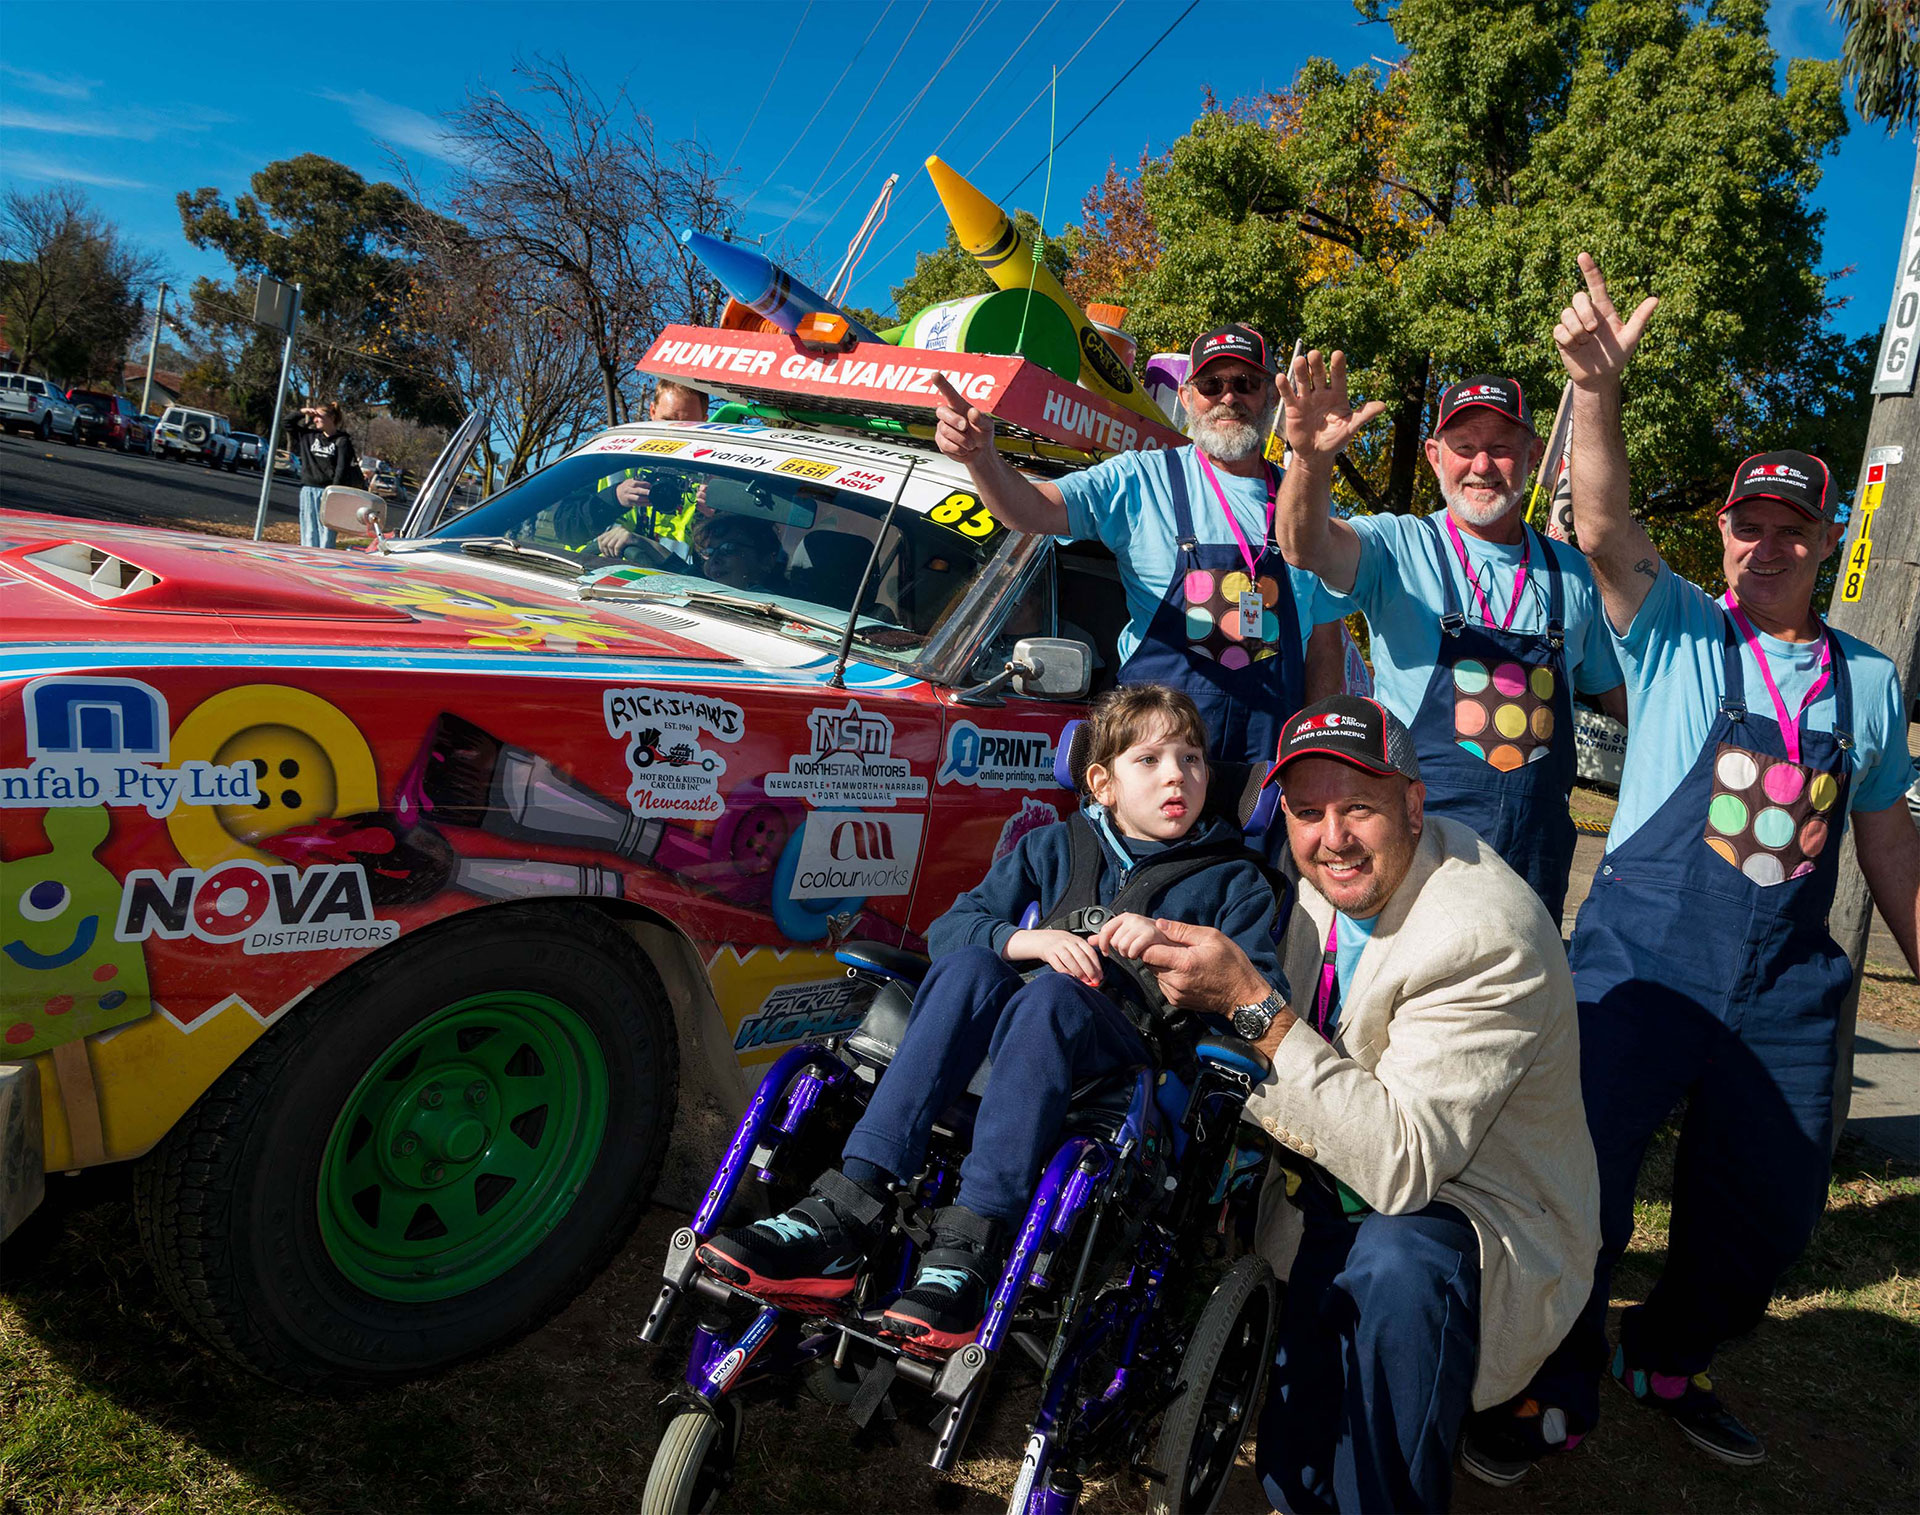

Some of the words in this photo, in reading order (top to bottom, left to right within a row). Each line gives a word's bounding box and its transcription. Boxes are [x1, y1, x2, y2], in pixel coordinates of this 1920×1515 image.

[1887, 212, 1920, 373] 406
[652, 340, 776, 375] HUNTER
[780, 354, 996, 400] GALVANIZING
[1043, 390, 1138, 451] HUNTER
[638, 443, 680, 453] BASH
[709, 449, 773, 469] variety
[781, 462, 828, 478] BASH
[847, 470, 886, 484] AHA
[834, 477, 877, 492] NSW
[931, 494, 995, 537] 85
[611, 695, 738, 735] RICKSHAWS
[664, 722, 677, 731] EST.
[678, 723, 693, 732] 1961
[812, 714, 888, 754] NSM
[1296, 721, 1312, 734] HG
[1574, 724, 1609, 741] ENNE
[1290, 732, 1315, 745] HUNTER
[1316, 730, 1366, 740] GALVANIZING
[1577, 737, 1626, 754] BATHURS
[640, 772, 655, 782] HOT
[657, 773, 673, 783] ROD
[681, 774, 711, 785] KUSTOM
[795, 762, 860, 777] NORTHSTAR
[862, 764, 907, 778] MOTORS
[980, 770, 1004, 781] online
[1006, 770, 1037, 784] printing,
[115, 767, 179, 810] Pty
[190, 767, 253, 799] Ltd
[650, 781, 665, 790] CAR
[666, 781, 684, 790] CLUB
[770, 780, 825, 790] NEWCASTLE
[831, 781, 879, 790] TAMWORTH
[885, 782, 925, 791] NARRABRI
[634, 788, 719, 812] Newcastle
[818, 791, 840, 800] PORT
[843, 792, 892, 801] MACQUARIE
[800, 865, 909, 889] colourworks
[124, 866, 367, 937] NOVA
[251, 926, 393, 949] DISTRIBUTORS
[773, 984, 820, 998] FISHERMAN'S
[765, 988, 855, 1018] TACKLE
[712, 1355, 737, 1381] PME
